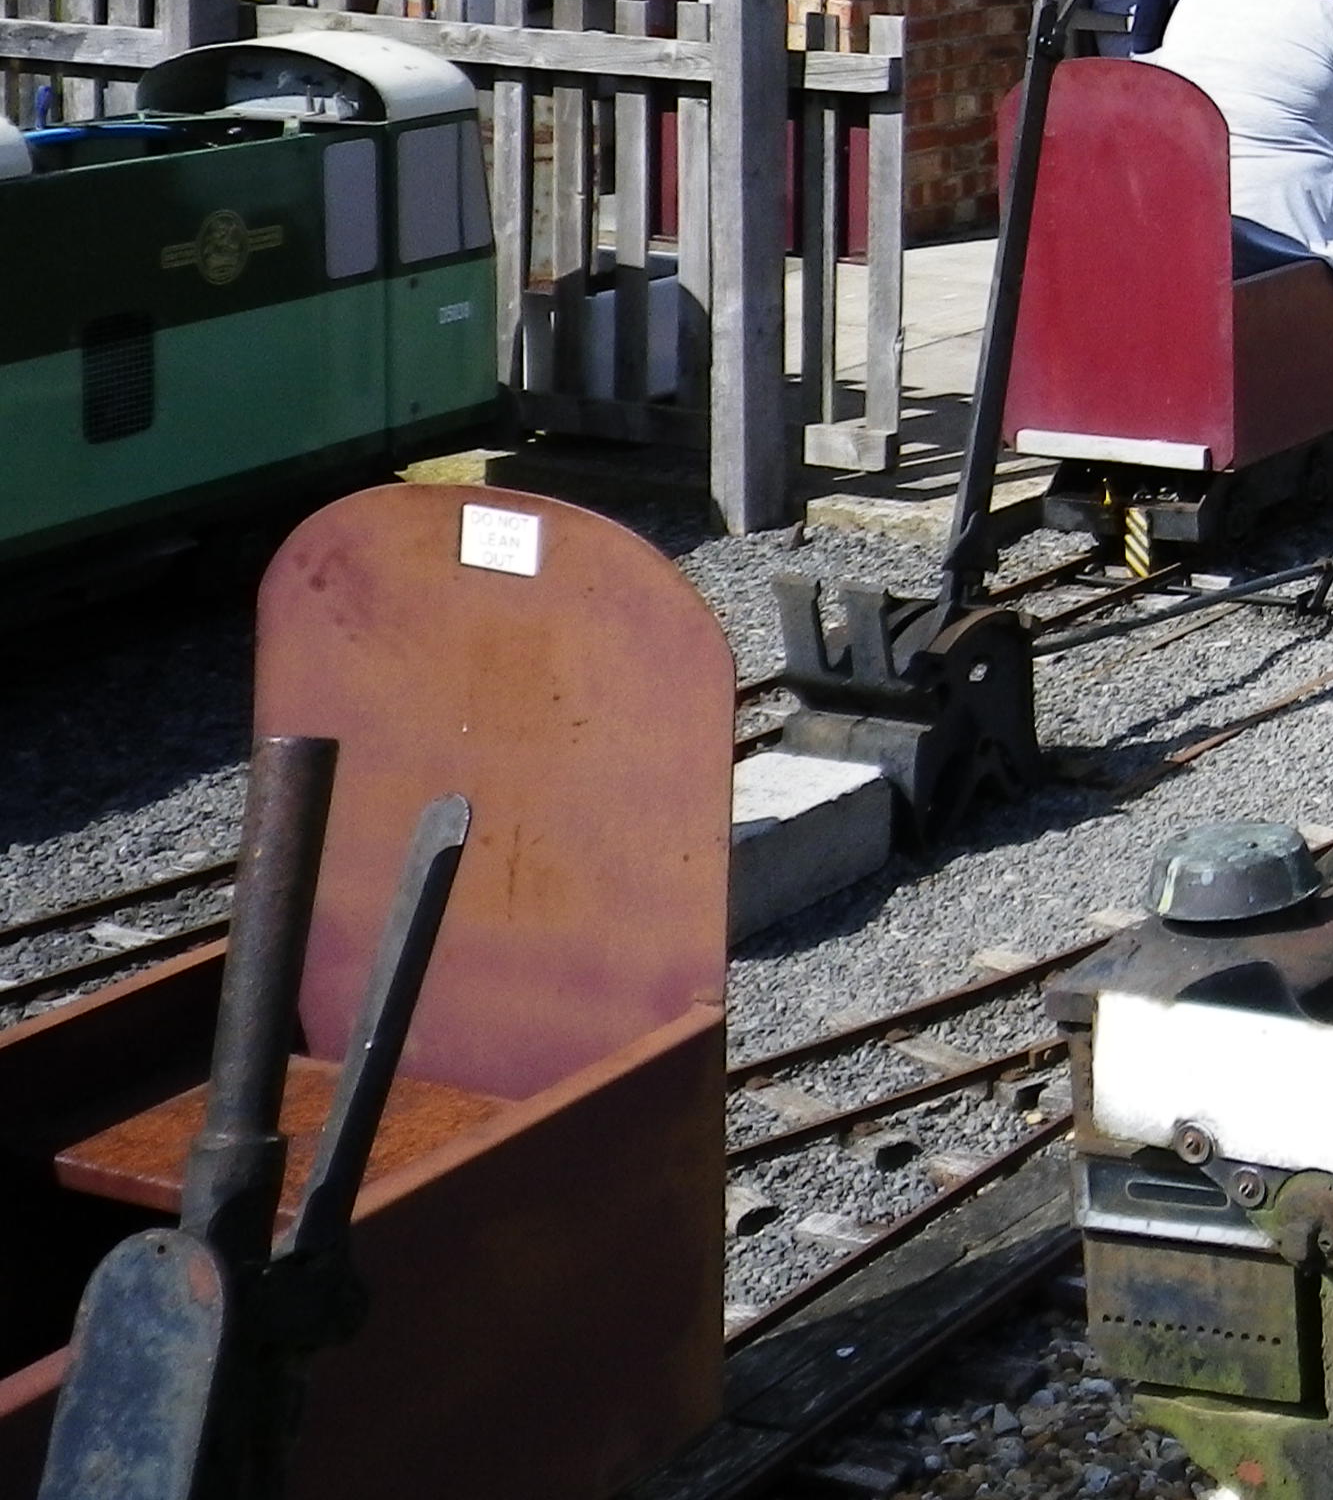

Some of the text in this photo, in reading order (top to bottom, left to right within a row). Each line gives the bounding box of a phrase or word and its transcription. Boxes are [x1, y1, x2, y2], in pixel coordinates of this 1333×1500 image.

[471, 510, 529, 532] DO NOT
[480, 531, 521, 550] LEAN
[483, 550, 516, 568] OUT
